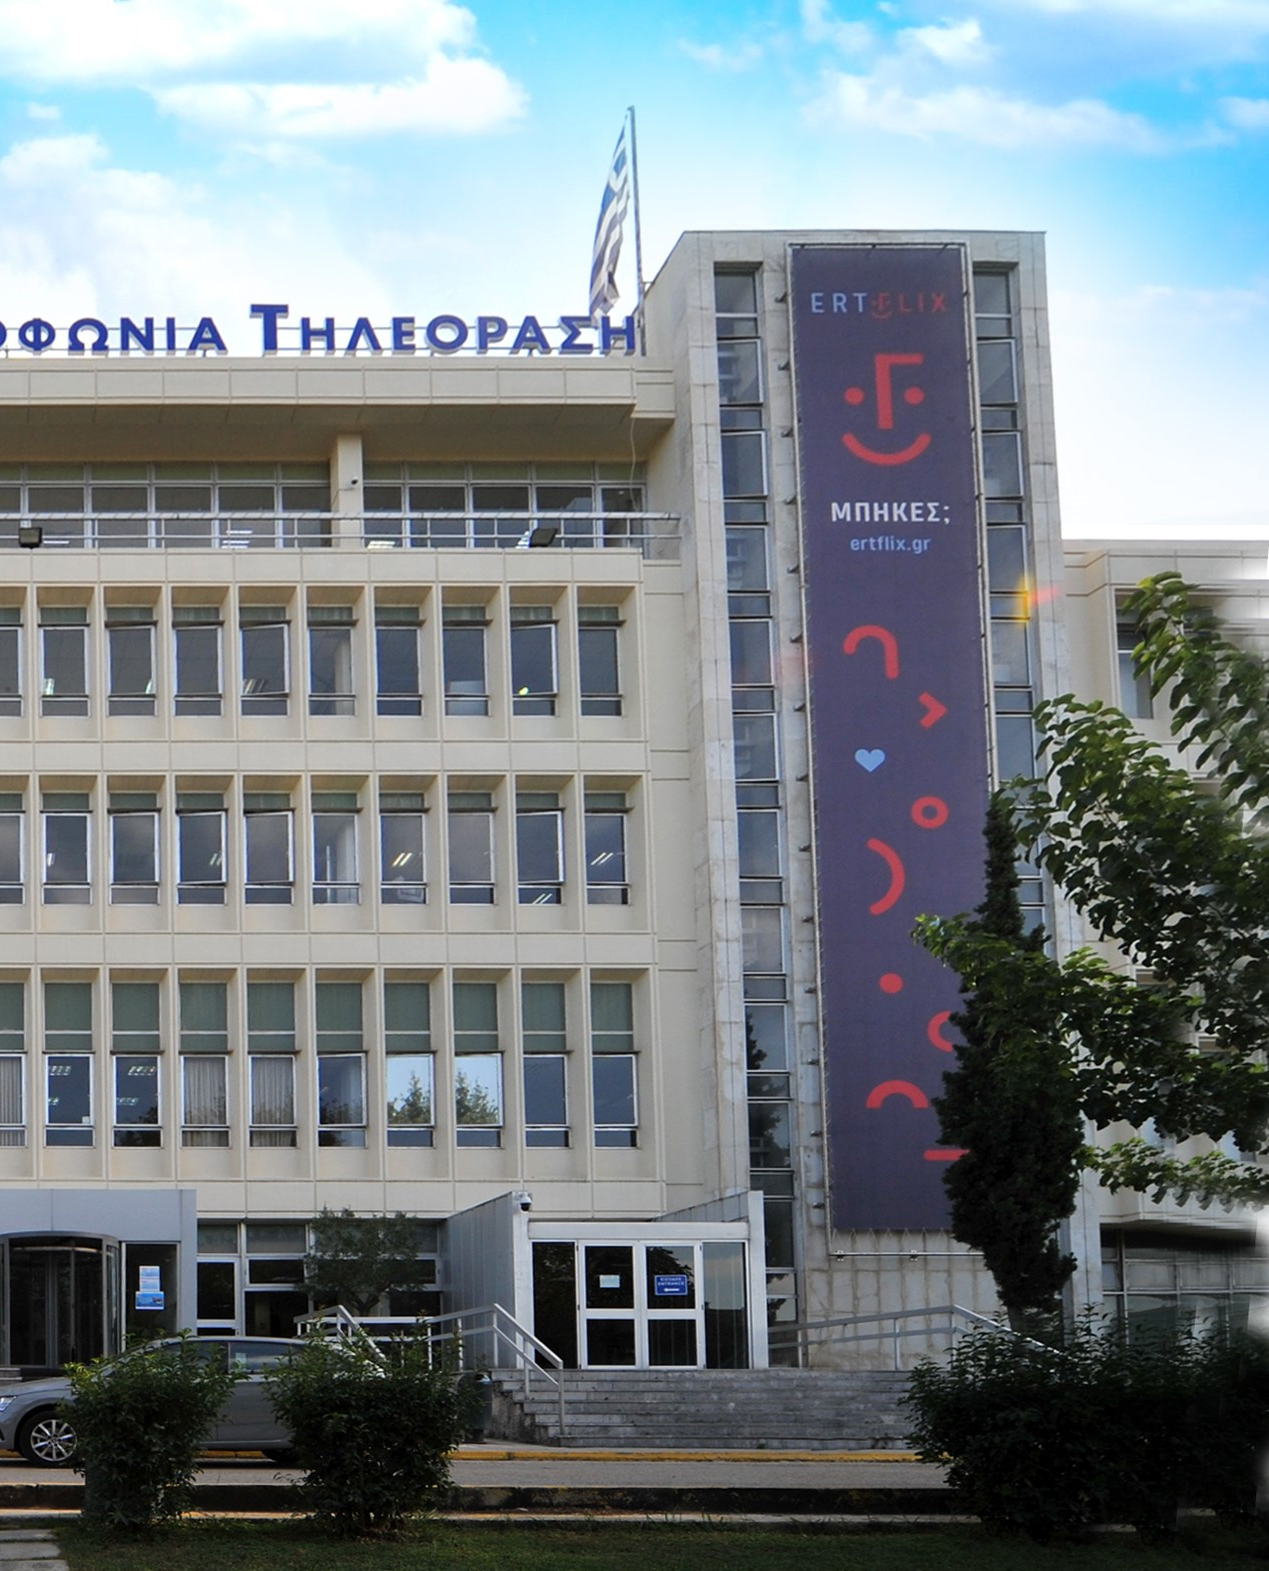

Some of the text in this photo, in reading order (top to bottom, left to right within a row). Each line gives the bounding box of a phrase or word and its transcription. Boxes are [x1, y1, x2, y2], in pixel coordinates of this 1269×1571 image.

[250, 304, 637, 355] ΤΗΛΕΟΡΑΣΗ
[831, 501, 951, 524] ΜΠΗΚΕΣ;
[849, 534, 932, 555] ertflix.gr
